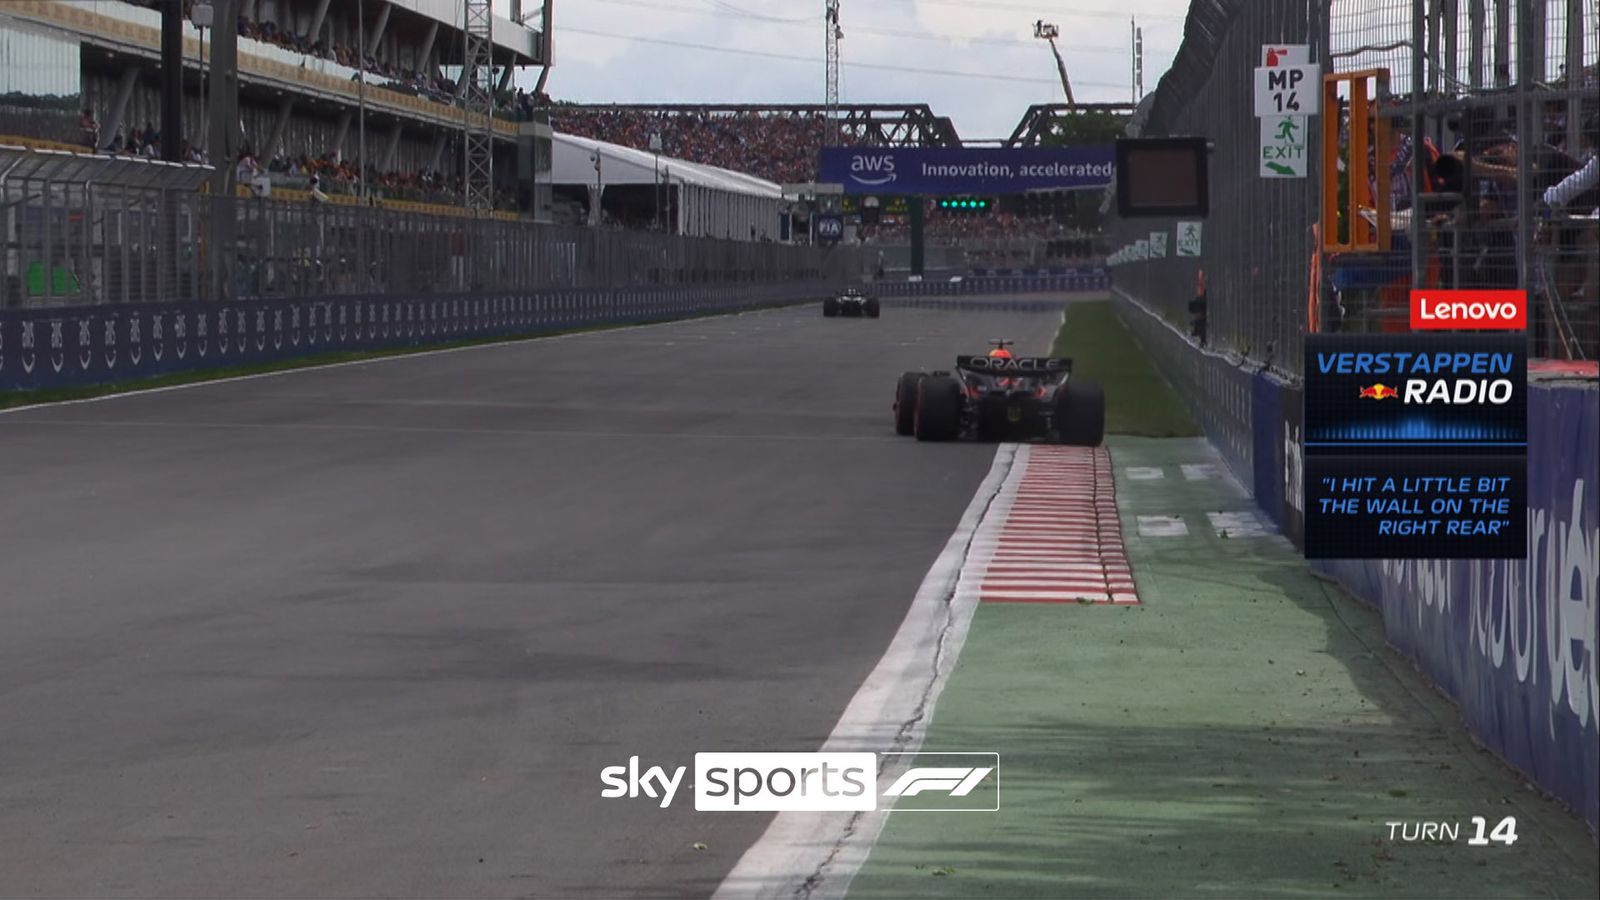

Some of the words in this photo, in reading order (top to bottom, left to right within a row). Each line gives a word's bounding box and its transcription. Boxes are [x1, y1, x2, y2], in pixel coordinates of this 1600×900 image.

[1268, 69, 1303, 90] MP
[1273, 92, 1300, 112] 14
[1263, 146, 1304, 159] EXIT
[851, 155, 895, 171] aws
[922, 163, 1015, 178] Innovation,
[1020, 162, 1112, 176] accelerated
[969, 357, 1058, 369] ORACLE
